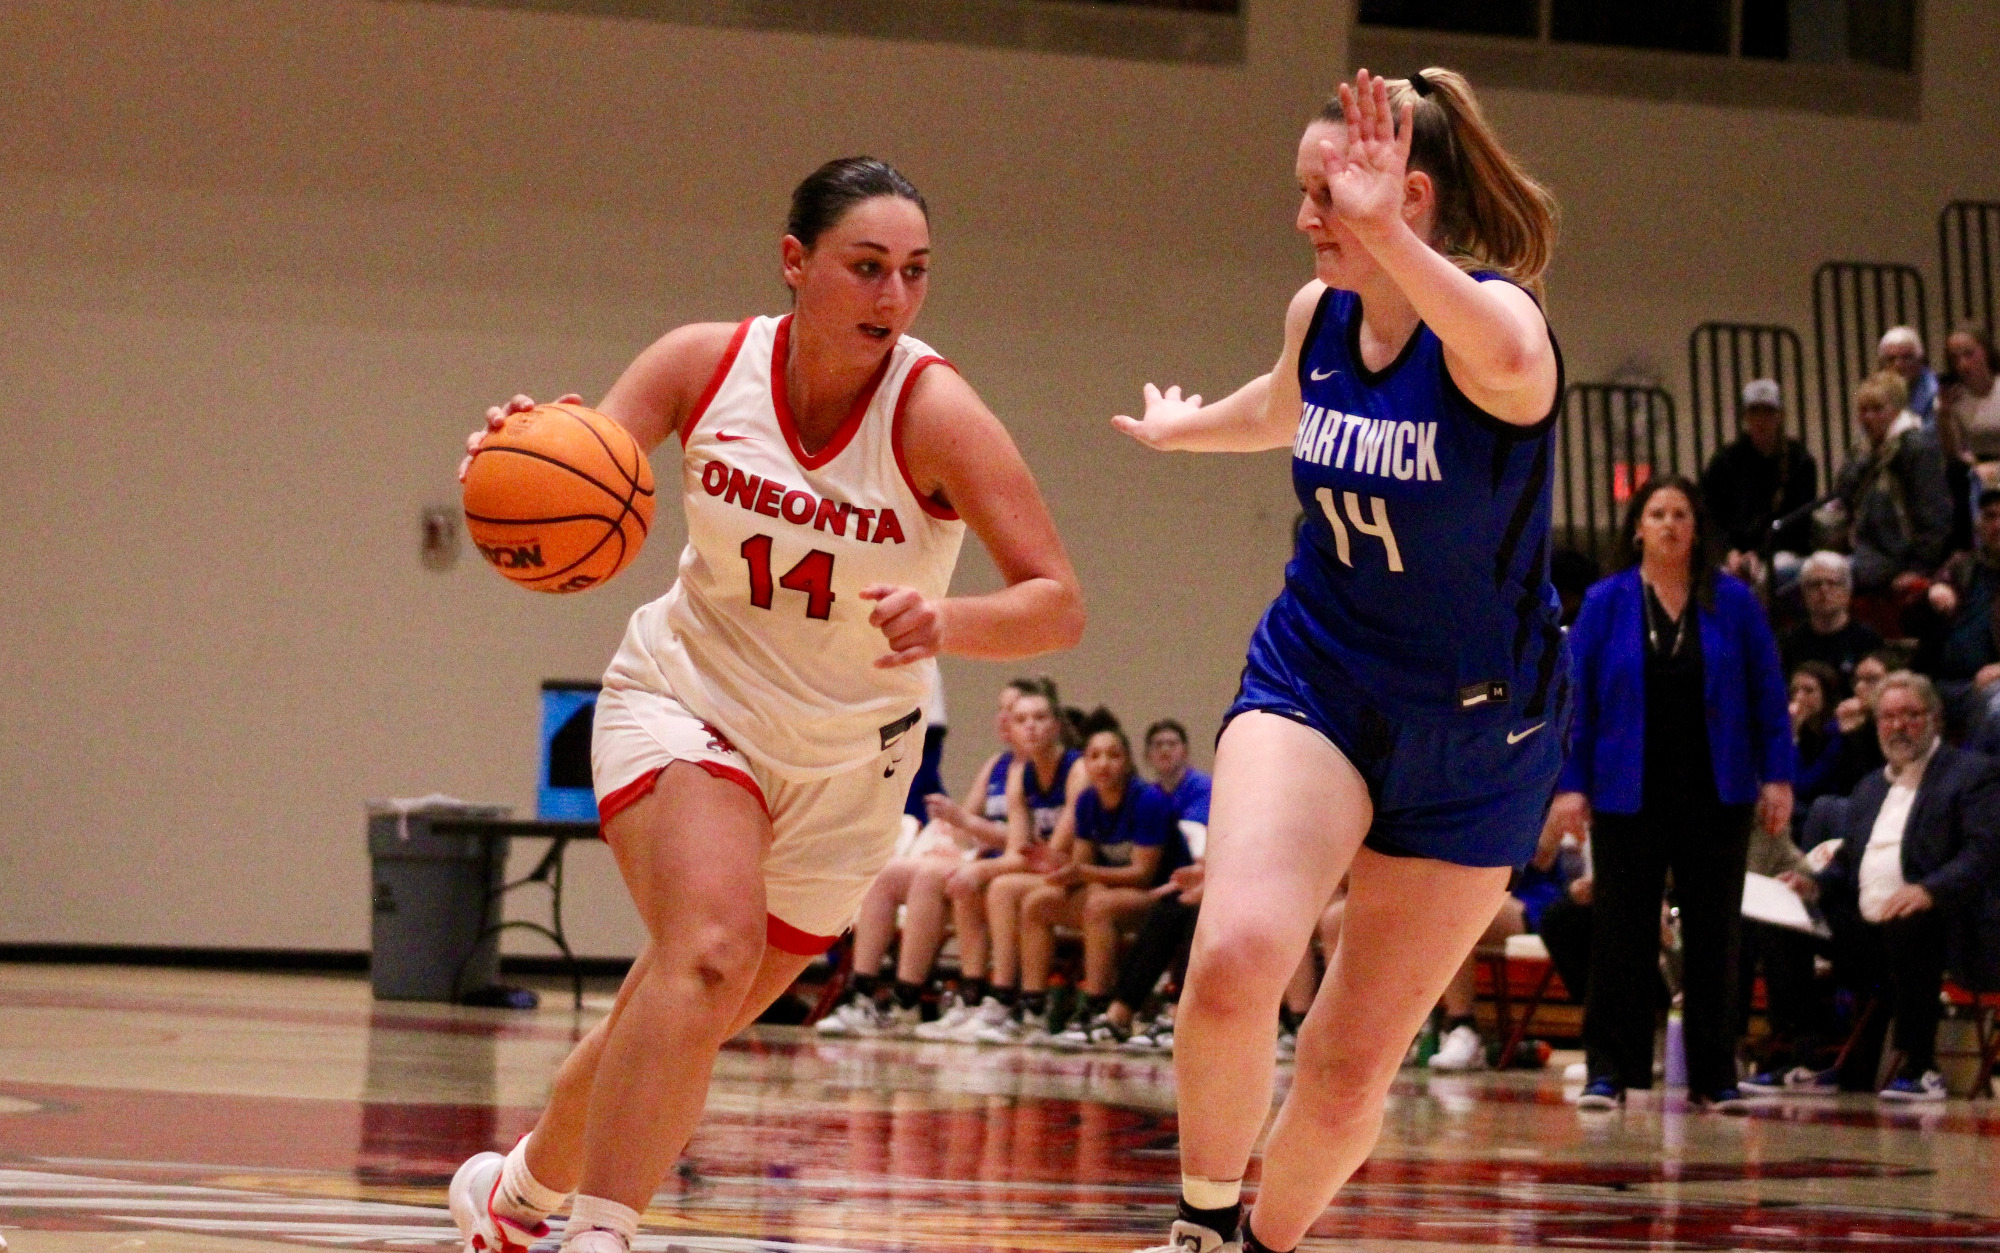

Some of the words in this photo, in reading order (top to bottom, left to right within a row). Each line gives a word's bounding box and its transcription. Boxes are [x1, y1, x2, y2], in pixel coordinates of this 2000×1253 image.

[1293, 401, 1442, 481] HARTWICK
[701, 460, 906, 544] ONEONTA
[1314, 486, 1404, 572] 14
[740, 533, 836, 621] 14
